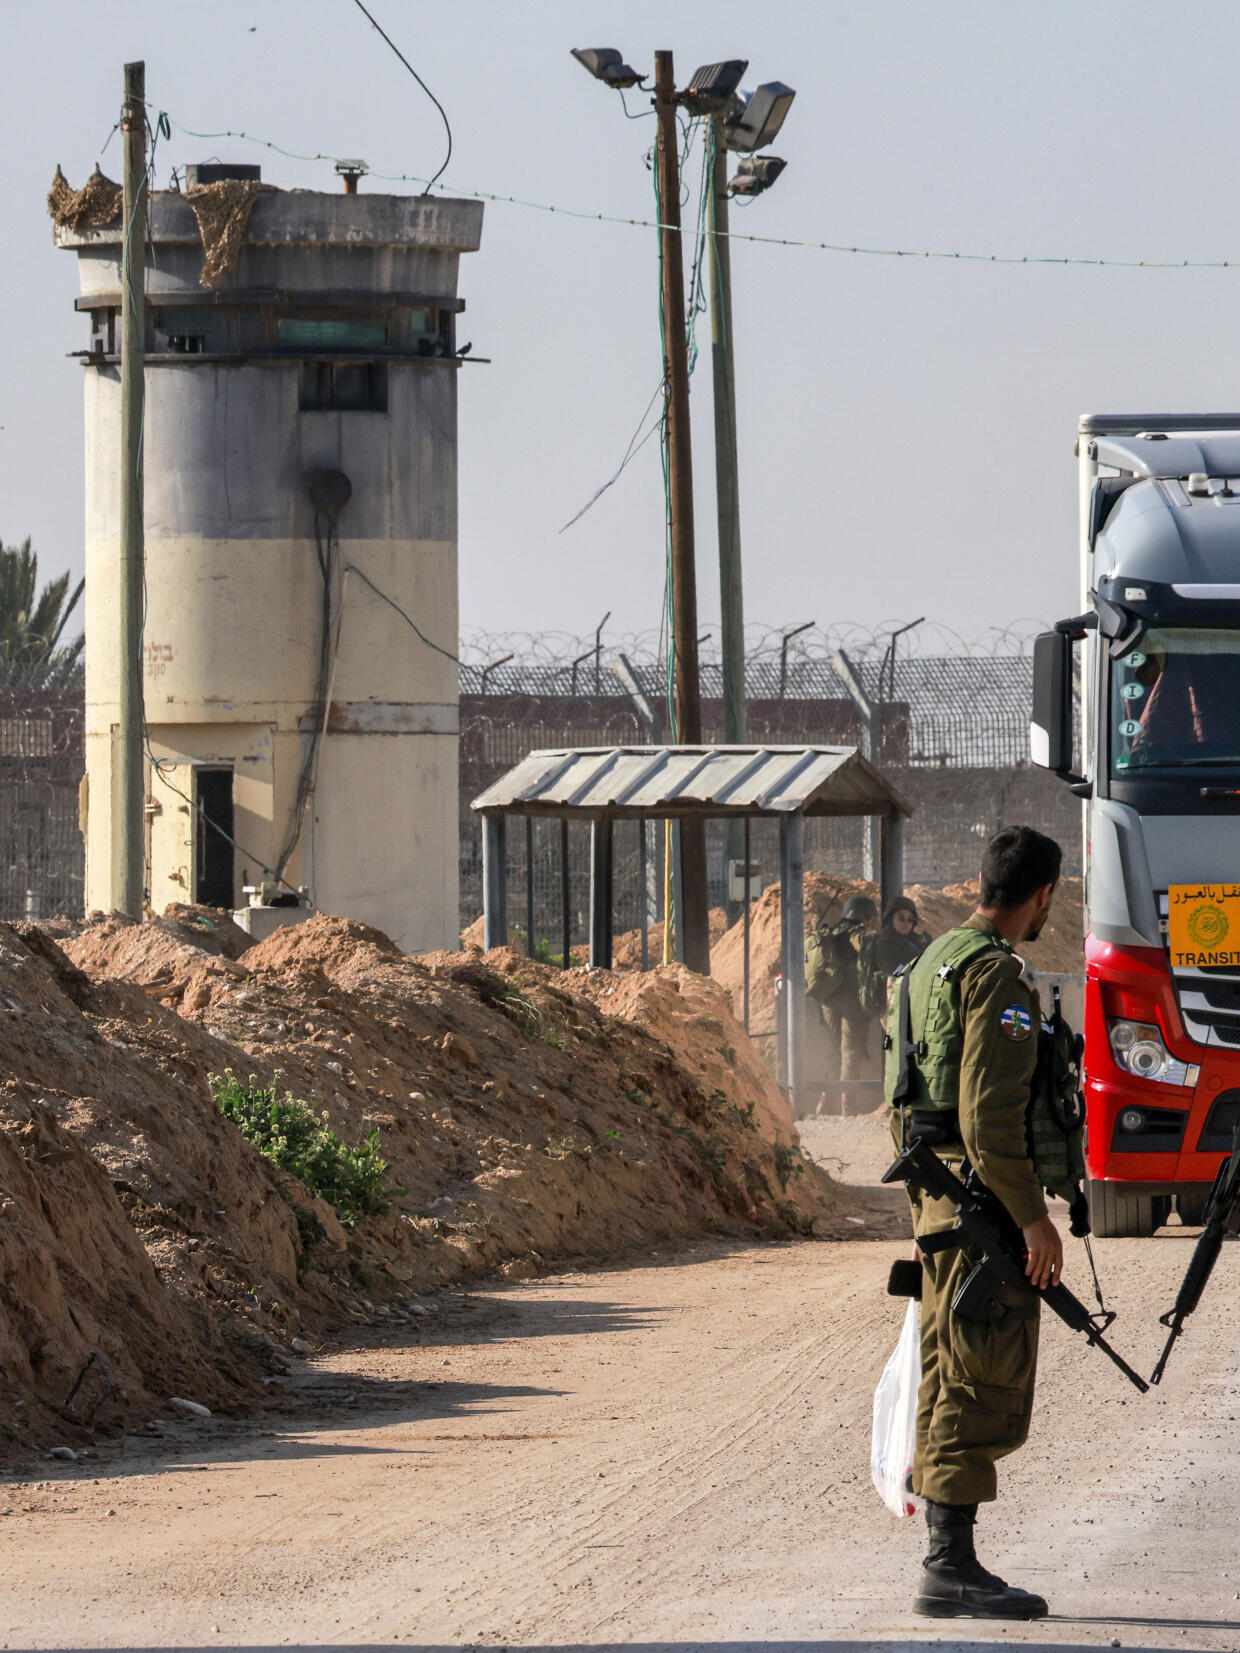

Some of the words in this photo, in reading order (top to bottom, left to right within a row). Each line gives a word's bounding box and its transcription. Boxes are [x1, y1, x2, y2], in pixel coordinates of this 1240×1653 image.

[1131, 653, 1139, 665] F
[1129, 686, 1137, 697] I
[1126, 723, 1135, 734] D
